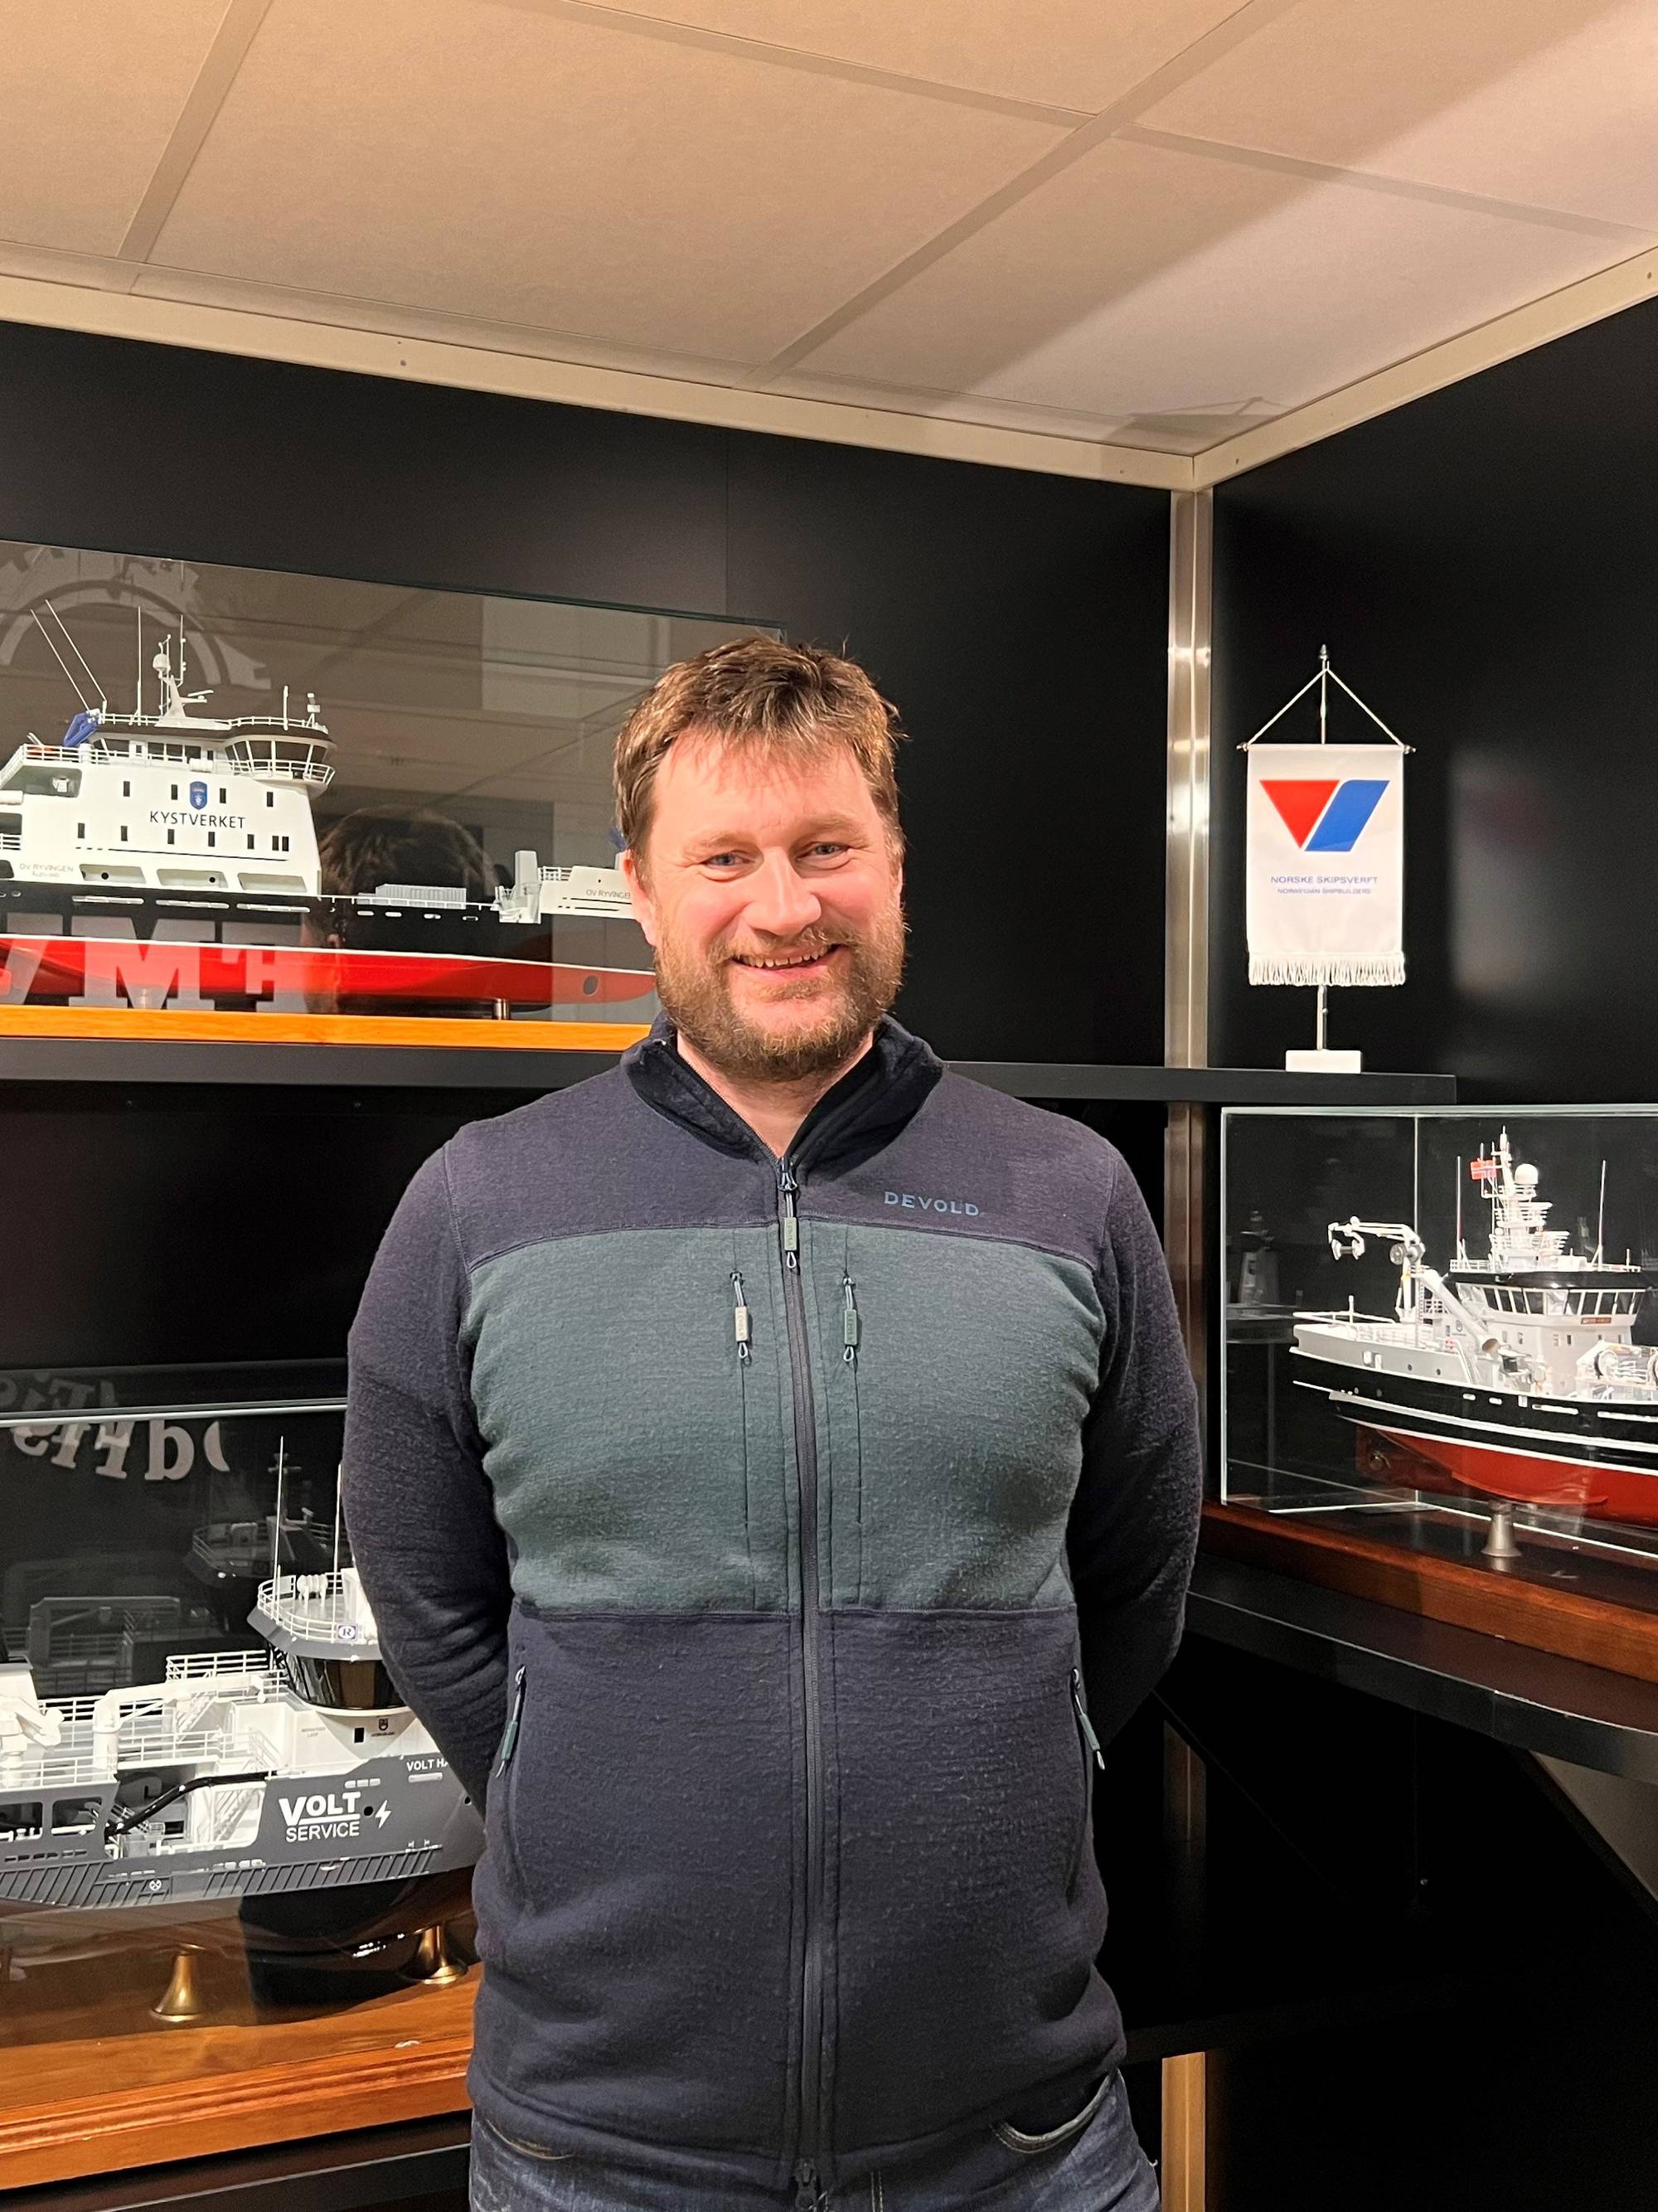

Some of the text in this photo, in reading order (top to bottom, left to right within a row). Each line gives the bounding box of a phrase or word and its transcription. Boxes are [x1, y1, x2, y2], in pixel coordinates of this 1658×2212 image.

[149, 810, 246, 829] KYSTVERKET
[1270, 876, 1379, 884] NORSKE SKIPSVERFT
[884, 1191, 980, 1216] DEVOLD
[406, 1758, 435, 1772] VOLT
[279, 1791, 361, 1826] VOLT
[285, 1821, 361, 1843] SERVICE
